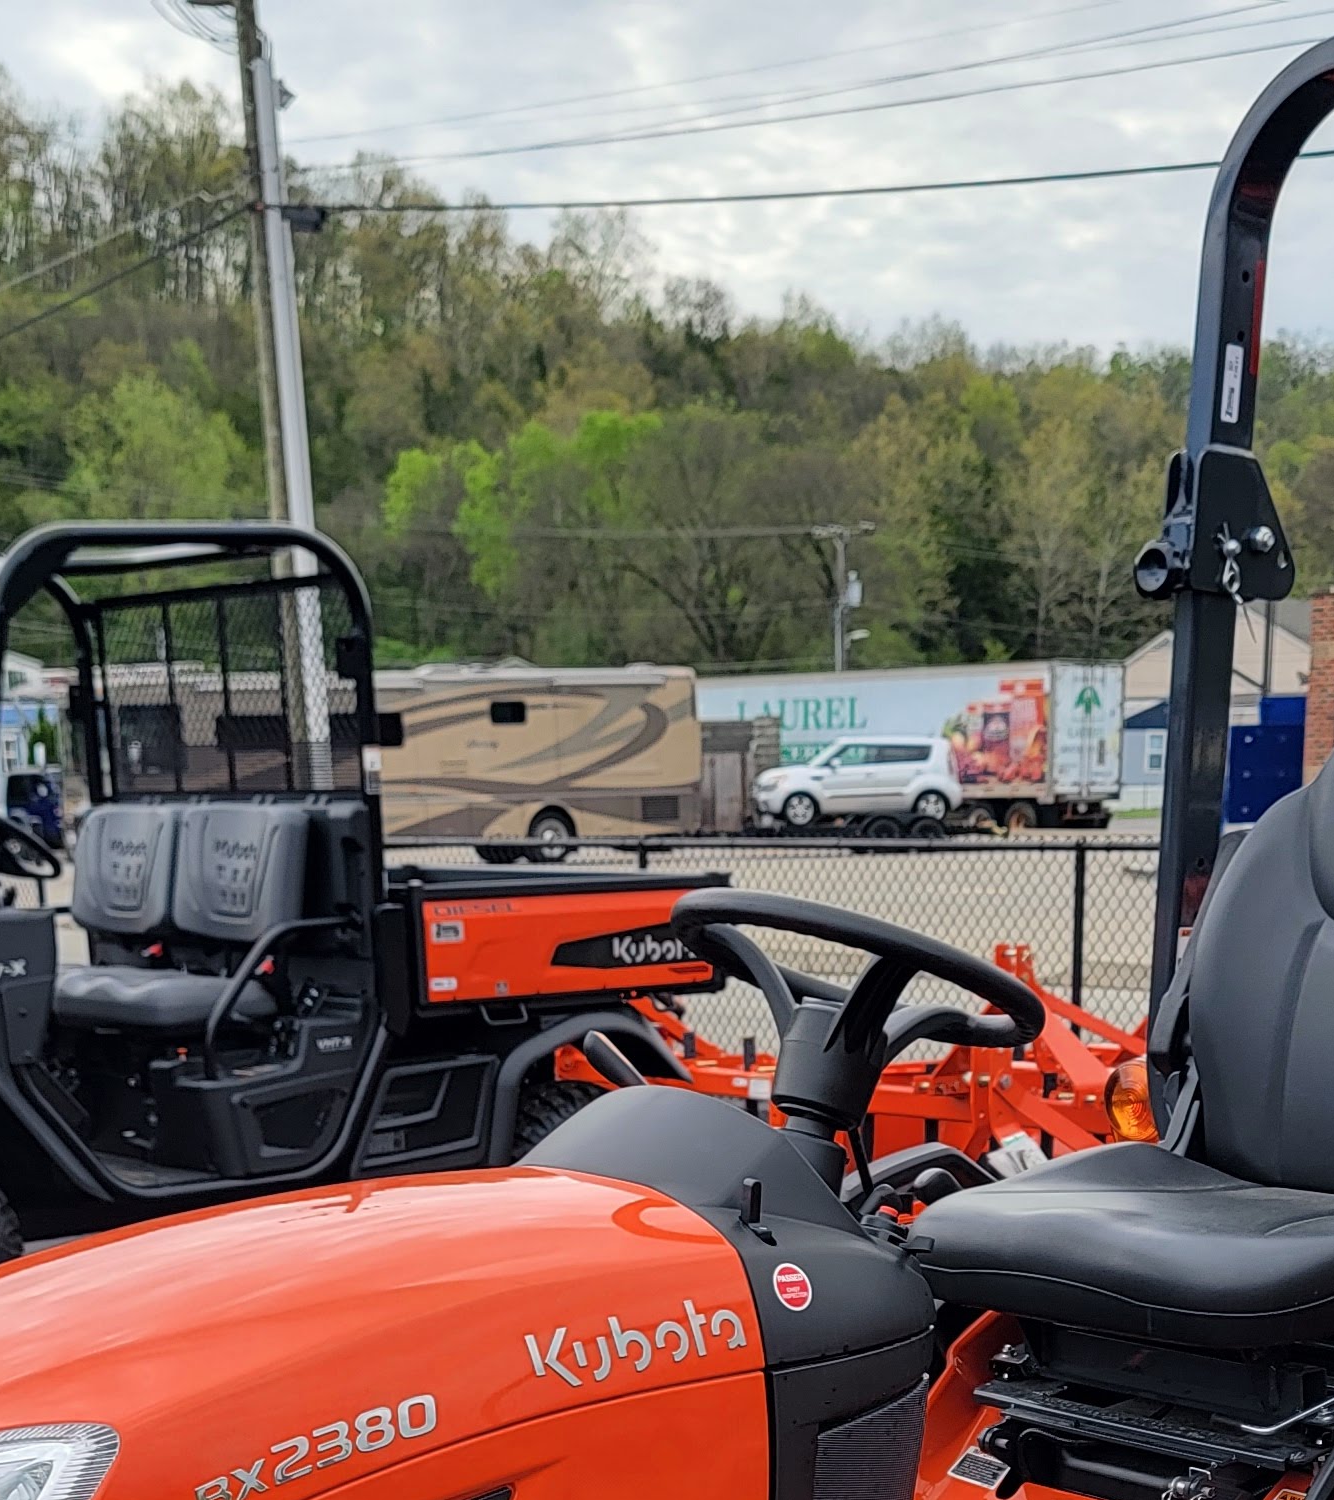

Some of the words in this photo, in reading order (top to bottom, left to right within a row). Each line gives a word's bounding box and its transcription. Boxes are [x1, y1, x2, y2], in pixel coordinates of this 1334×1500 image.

[433, 902, 521, 916] DIESEL
[611, 934, 697, 964] Kubot
[523, 1299, 747, 1387] Kubota
